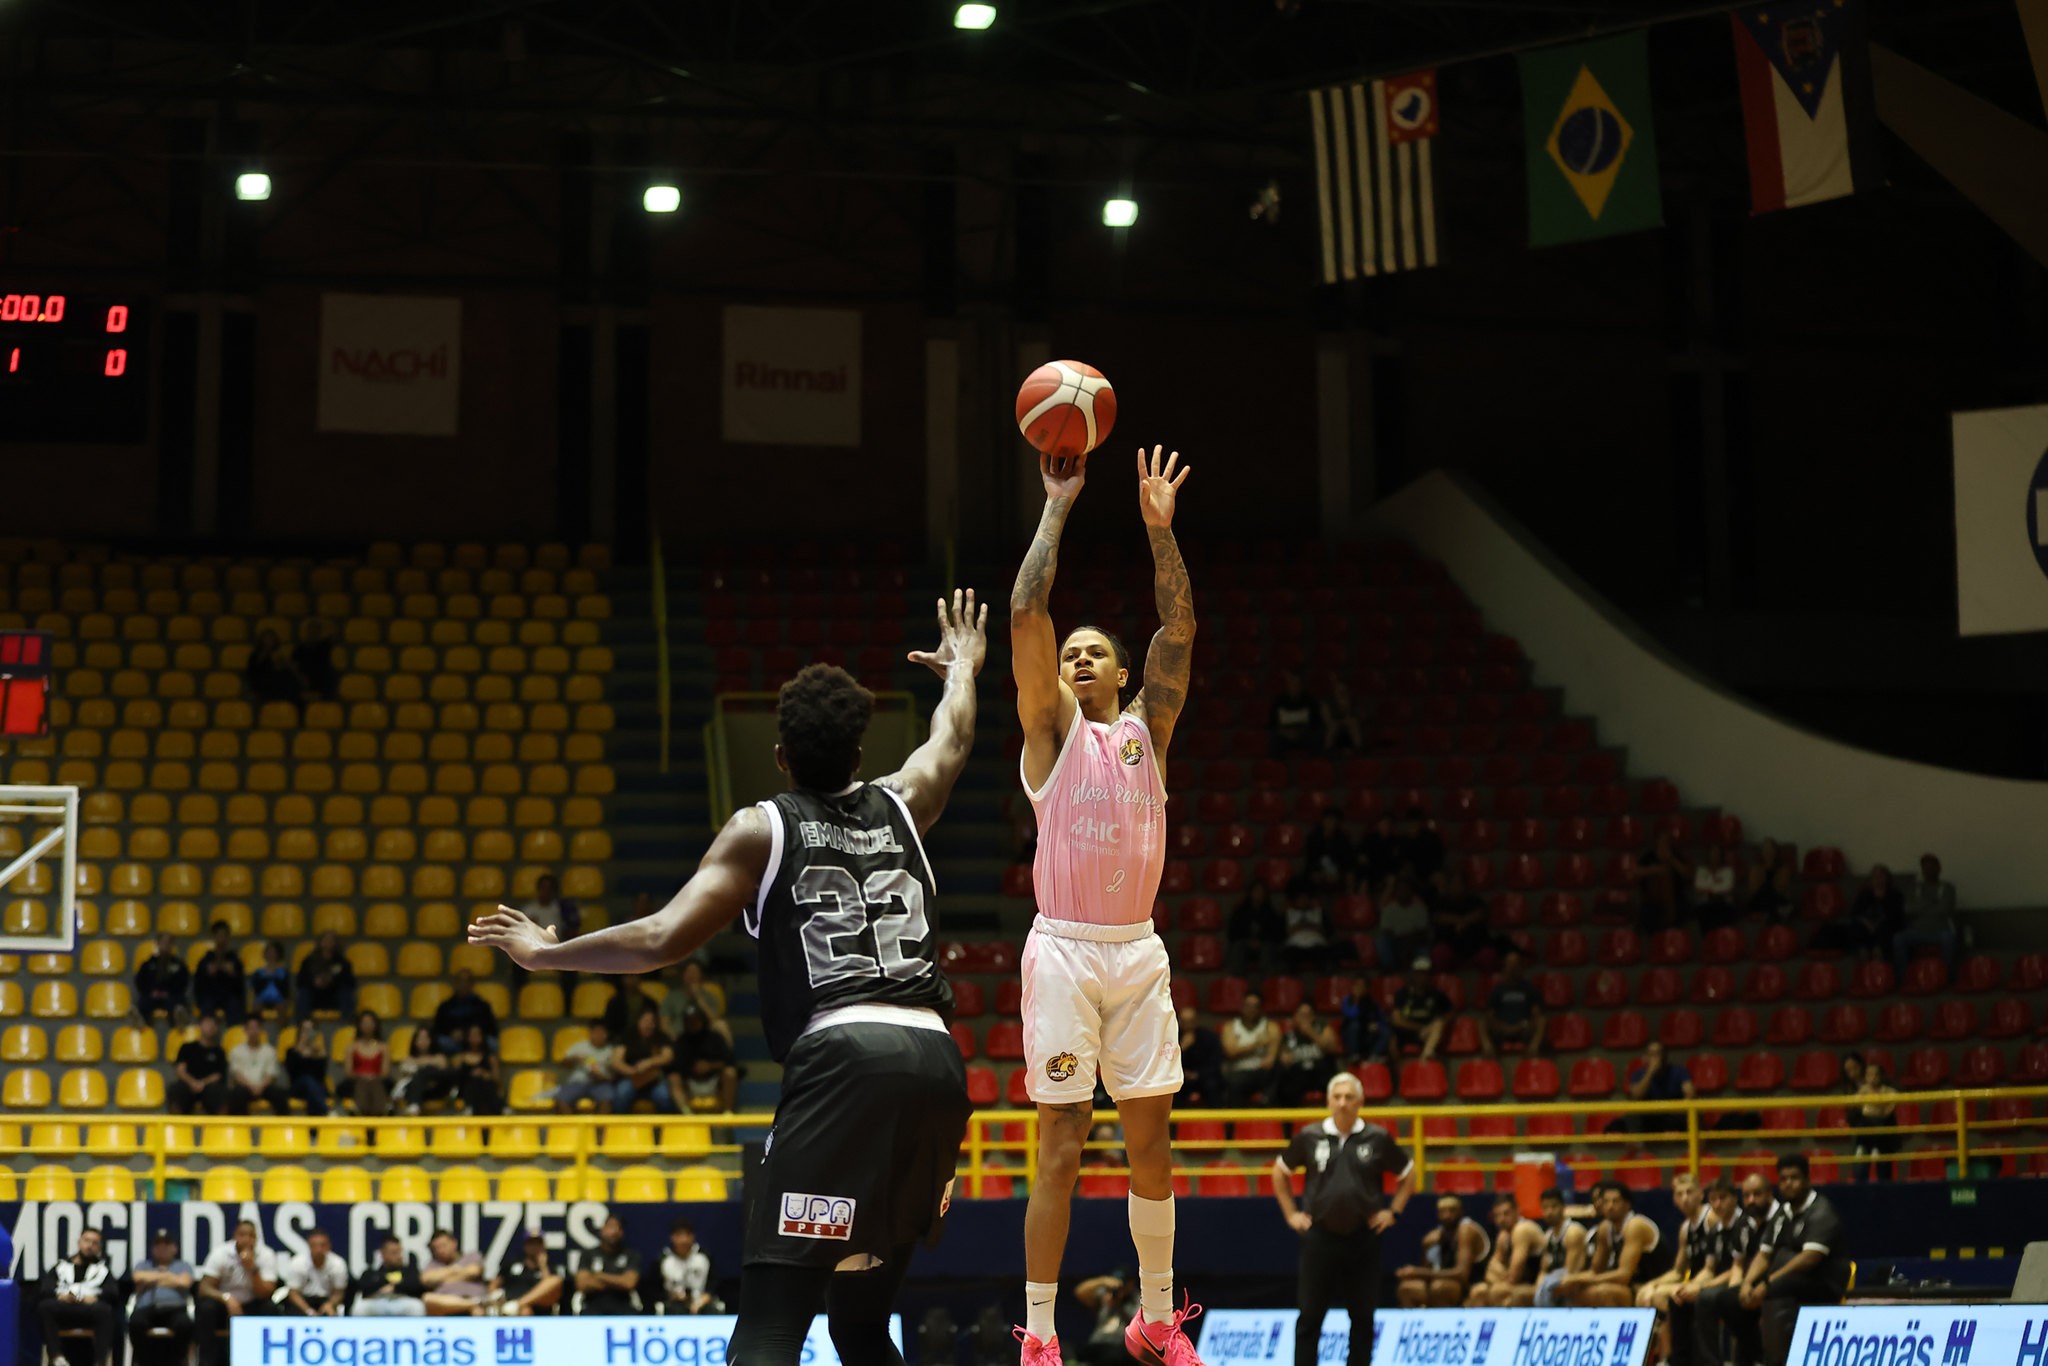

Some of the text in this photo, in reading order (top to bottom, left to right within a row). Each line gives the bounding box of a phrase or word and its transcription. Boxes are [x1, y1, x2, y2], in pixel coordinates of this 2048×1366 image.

[0, 295, 65, 322] 00.0
[106, 306, 128, 332] 0
[104, 349, 127, 376] 0
[736, 361, 846, 393] Rinnai
[800, 821, 904, 856] EMANUEL
[1086, 817, 1121, 844] HIC
[1106, 870, 1126, 894] 2
[792, 865, 934, 989] 22
[785, 1195, 852, 1225] UPA
[349, 1200, 610, 1280] CRUZES
[797, 1221, 838, 1235] PET
[262, 1327, 477, 1366] Höganäs
[1394, 1320, 1471, 1365] Höganäs
[1513, 1321, 1608, 1366] Höganäs
[1802, 1320, 1934, 1366] Höganäs
